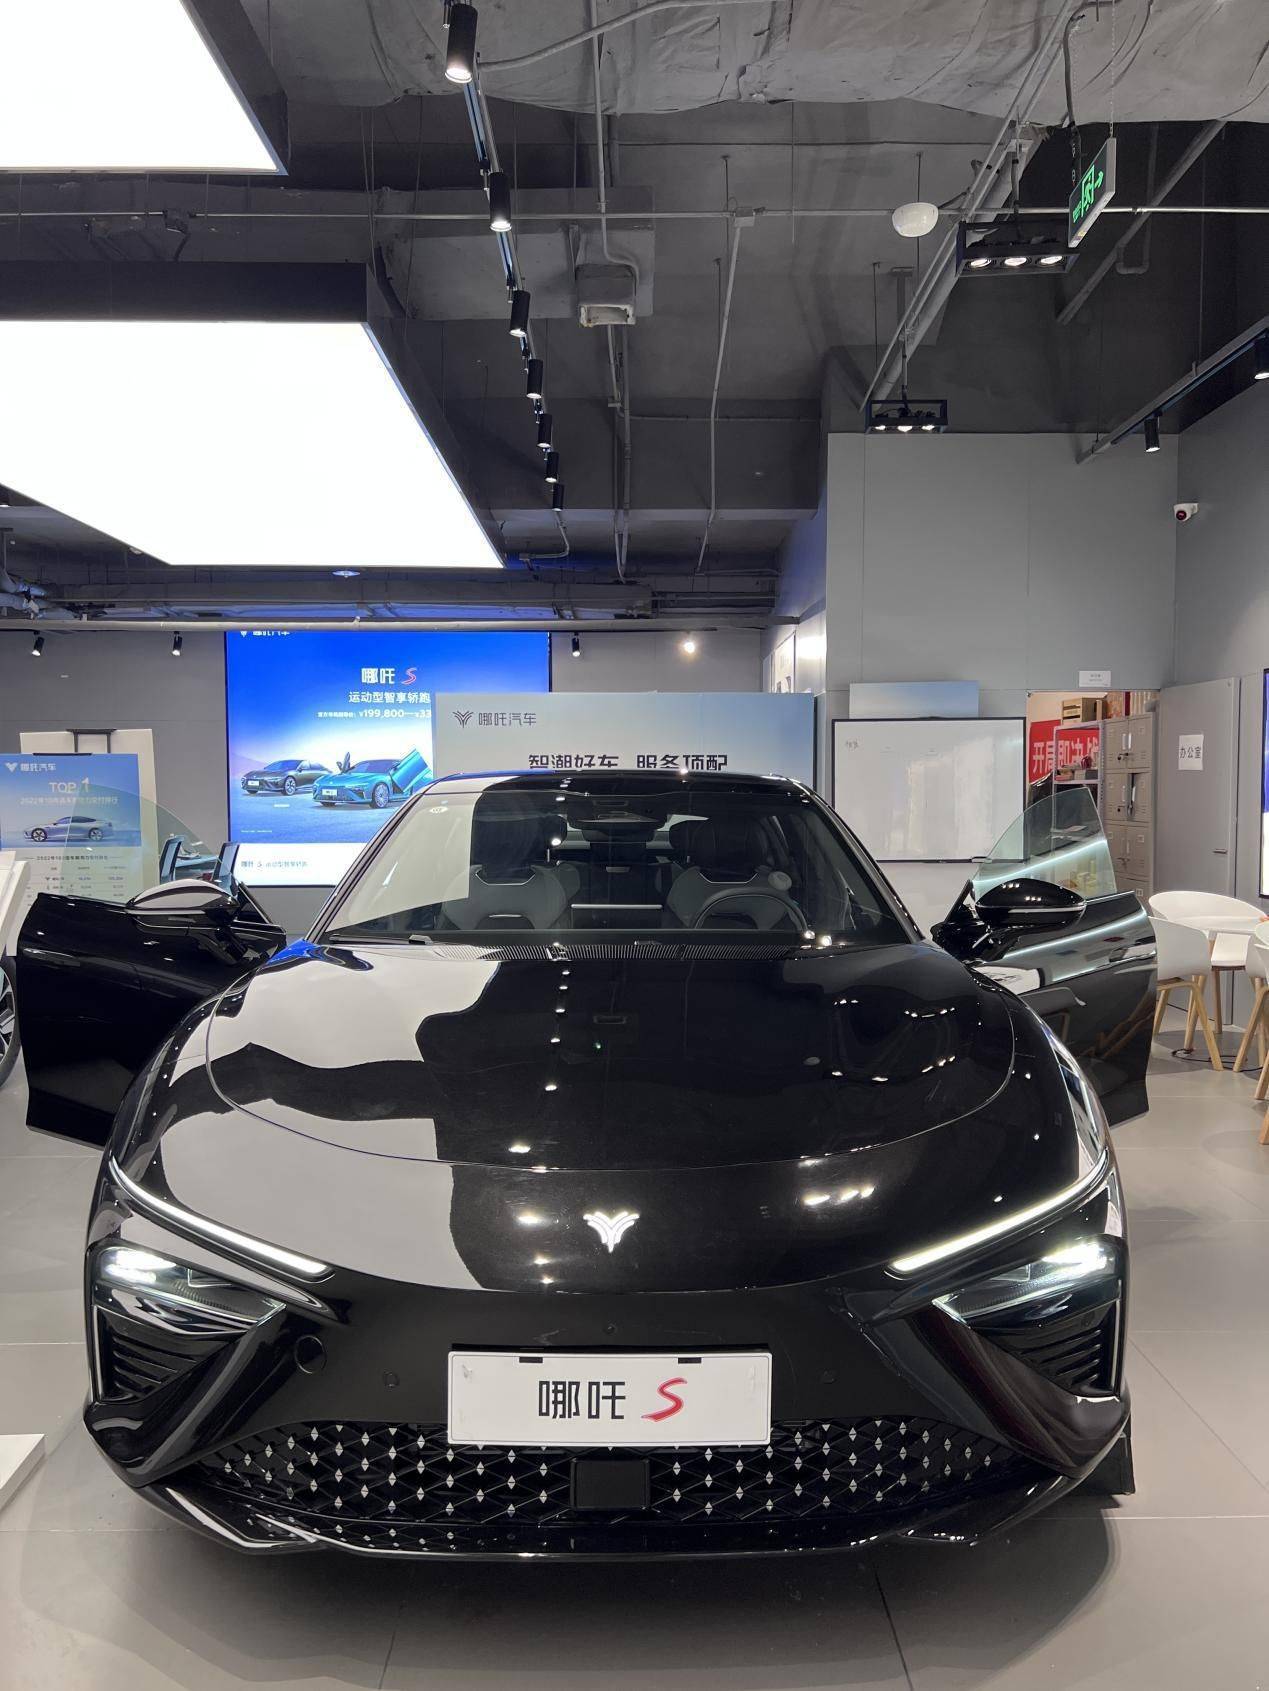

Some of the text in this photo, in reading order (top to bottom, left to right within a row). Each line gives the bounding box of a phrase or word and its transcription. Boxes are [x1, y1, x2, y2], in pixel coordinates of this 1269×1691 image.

[361, 667, 417, 685] 哪吒 S
[478, 712, 537, 726] 哪吒汽车
[1180, 746, 1202, 759] 办公室
[48, 782, 77, 793] TOP
[538, 1377, 688, 1422] 哪吒 S
